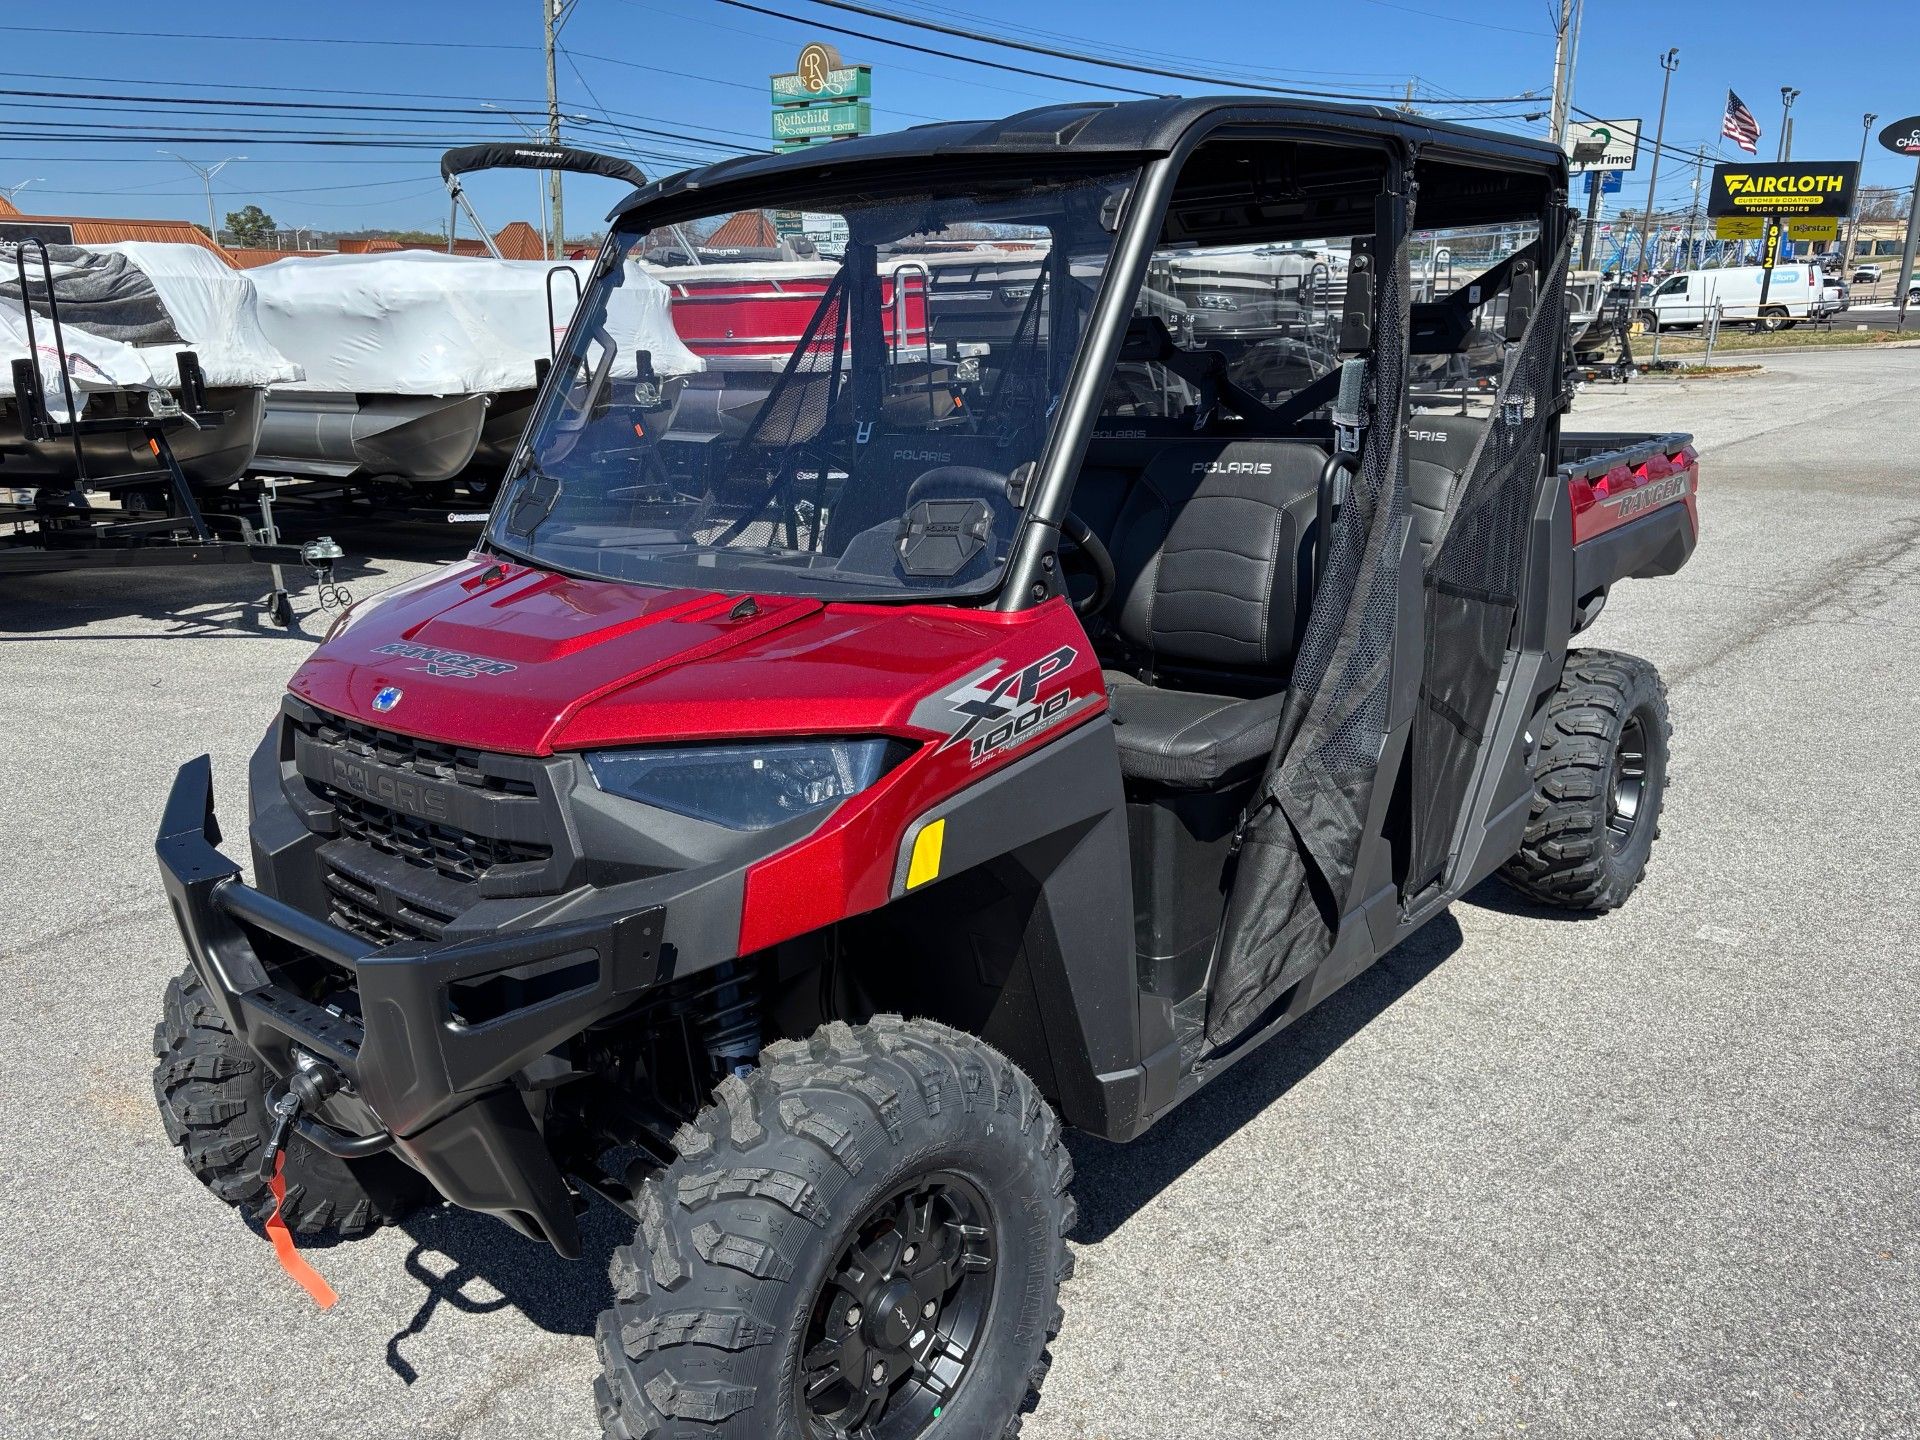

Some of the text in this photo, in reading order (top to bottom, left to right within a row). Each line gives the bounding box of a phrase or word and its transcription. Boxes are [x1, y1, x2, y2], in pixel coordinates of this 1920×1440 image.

[774, 110, 829, 133] Rothchild
[795, 123, 855, 135] CONFERENCE CENTER
[515, 149, 563, 159] PRINCECRAFT
[1723, 174, 1843, 196] FAIRCLOTH
[696, 246, 741, 257] Ranger
[1763, 225, 1779, 268] 8812
[1091, 430, 1146, 439] POLARIS
[893, 449, 951, 462] POLARIS
[1191, 461, 1272, 475] POLARIS
[1617, 475, 1684, 518] RANGER
[371, 643, 518, 676] RANGER
[404, 662, 479, 679] XP
[928, 644, 1079, 760] XP
[969, 687, 1071, 764] 1000
[971, 710, 1068, 770] DUAL OVERHEAD CAM
[333, 757, 448, 820] POLARIS
[894, 1306, 910, 1330] XP
